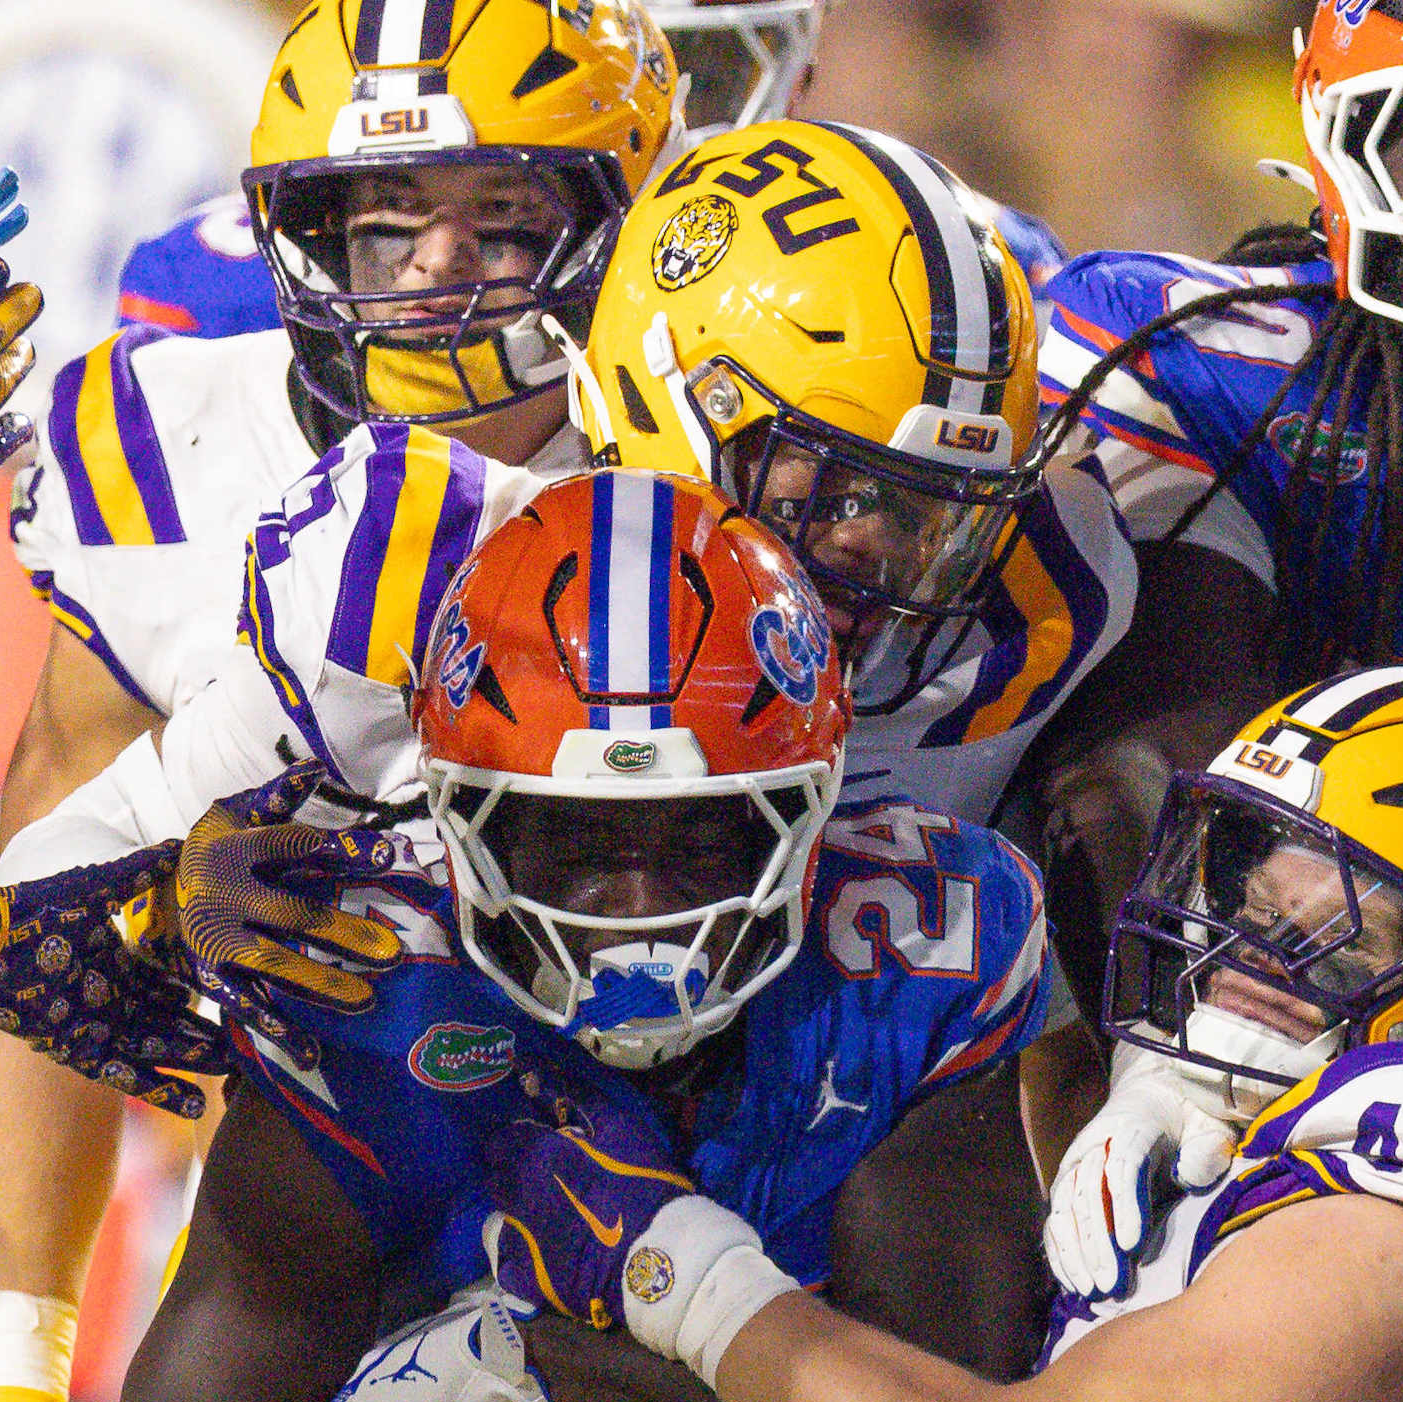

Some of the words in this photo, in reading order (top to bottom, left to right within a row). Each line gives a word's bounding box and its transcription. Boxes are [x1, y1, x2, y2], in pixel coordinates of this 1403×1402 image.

[361, 108, 429, 136] LSU
[654, 138, 861, 256] LSU
[934, 418, 999, 453] LSU
[1235, 744, 1294, 779] LSU
[338, 831, 359, 857] LSU
[821, 801, 982, 980] 24
